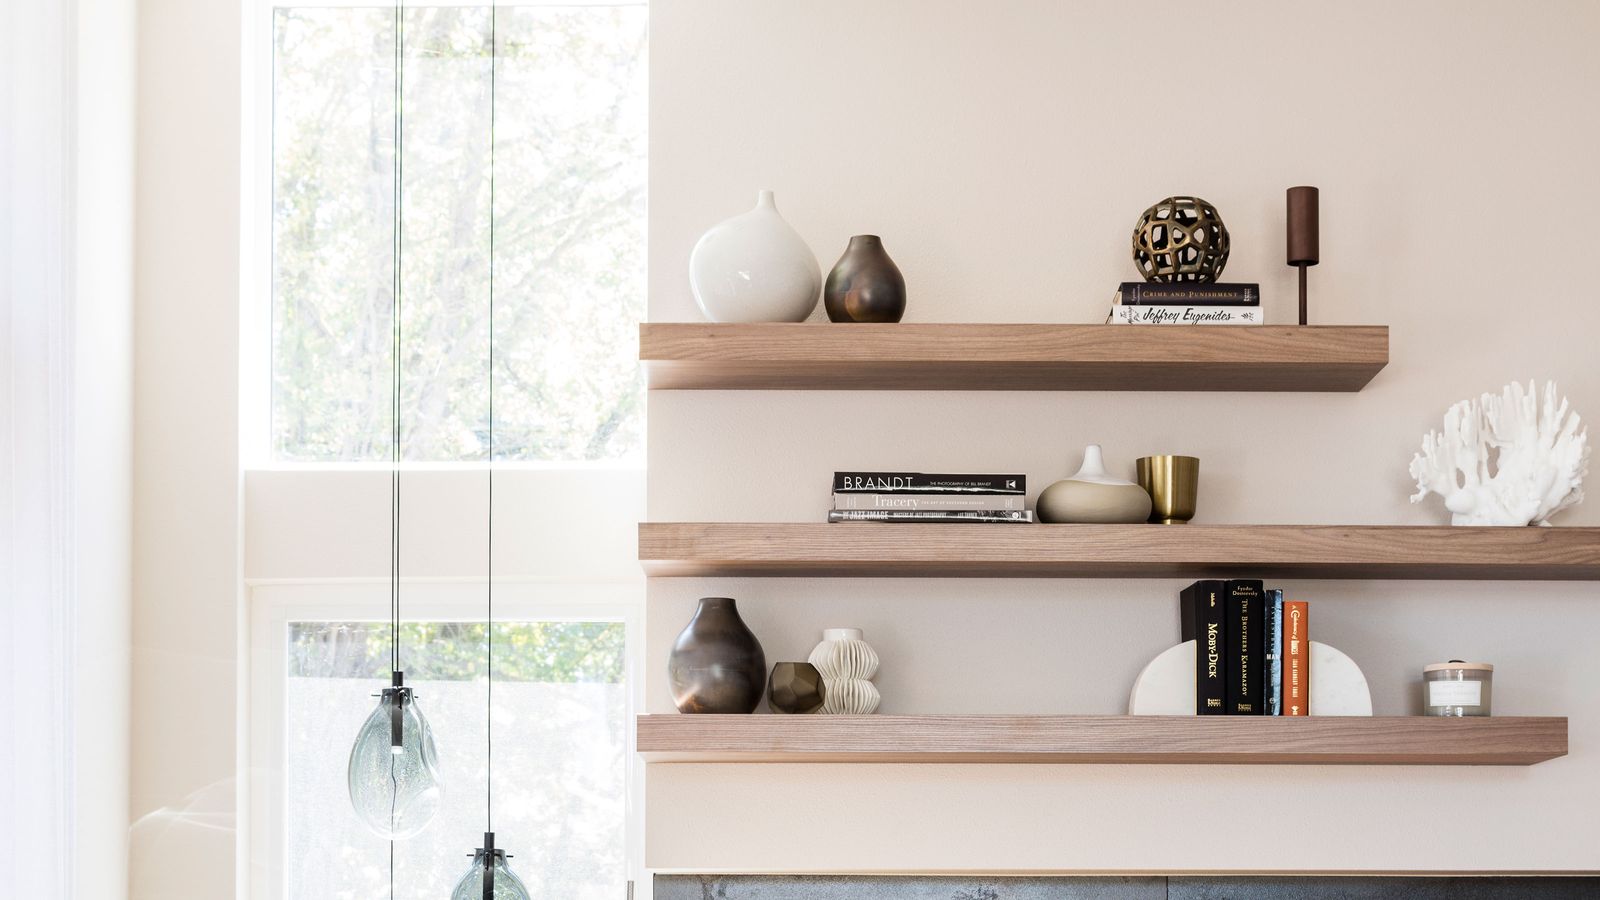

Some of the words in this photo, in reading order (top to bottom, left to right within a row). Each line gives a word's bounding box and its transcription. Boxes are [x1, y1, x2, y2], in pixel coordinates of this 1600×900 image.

[1142, 290, 1168, 298] CRIME
[1188, 291, 1238, 299] PUNISHMENT
[1142, 307, 1181, 324] Jeffrey
[1182, 307, 1232, 325] Eugenides
[844, 476, 914, 490] BRANDT
[871, 494, 919, 511] Tracery
[1241, 599, 1249, 613] THE
